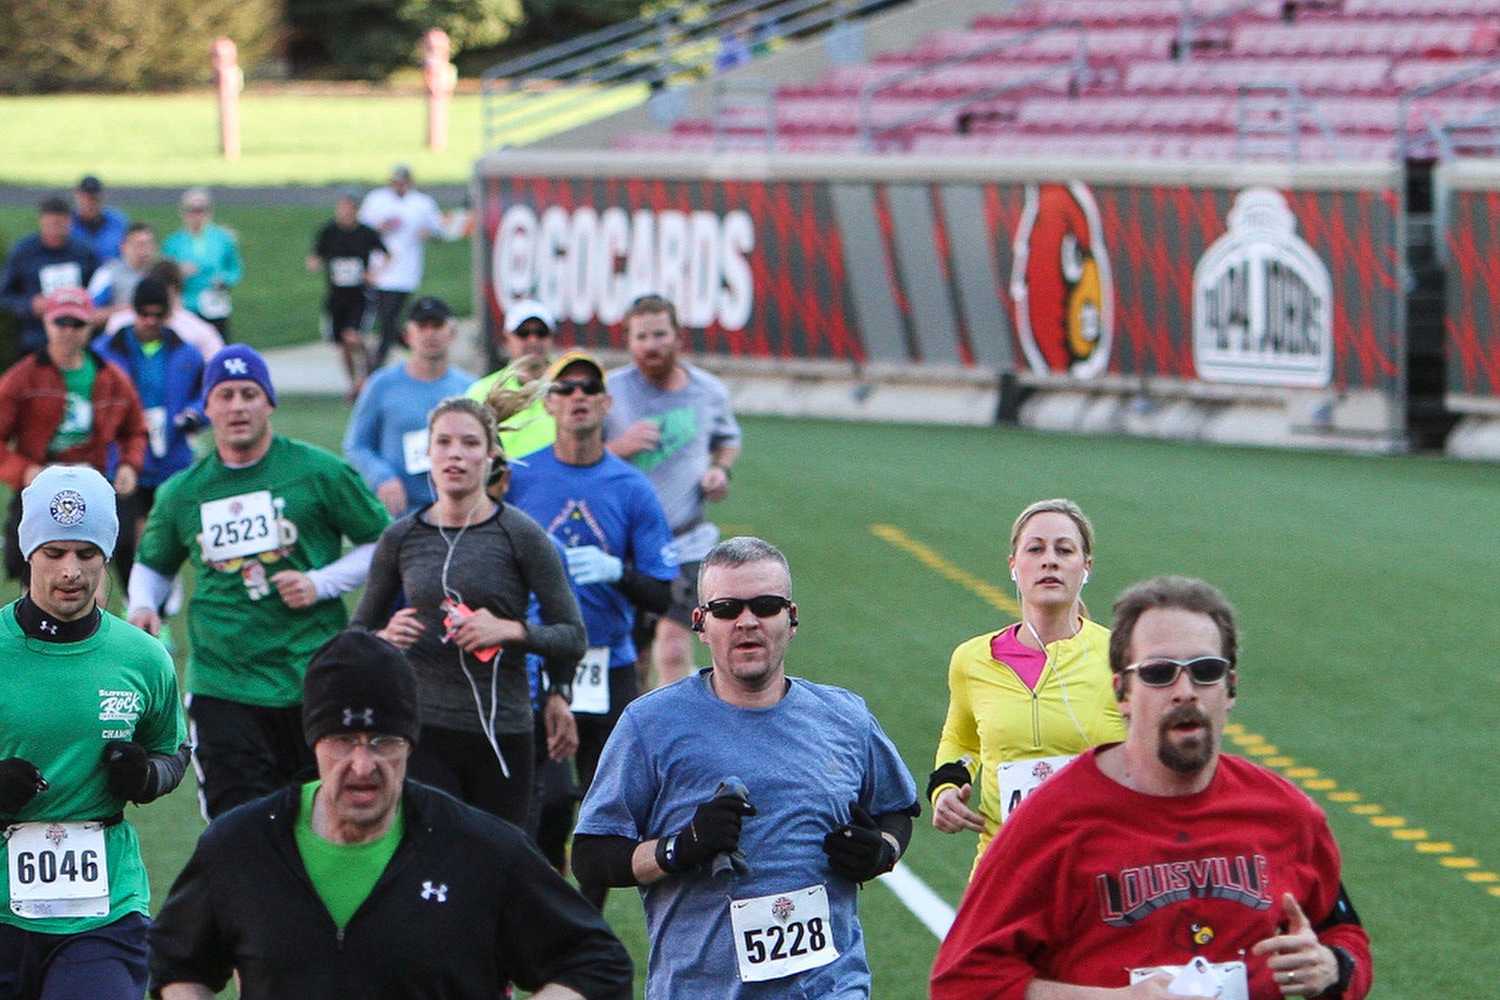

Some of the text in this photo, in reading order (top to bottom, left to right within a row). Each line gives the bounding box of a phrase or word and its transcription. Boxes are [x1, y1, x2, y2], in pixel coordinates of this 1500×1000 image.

[493, 204, 754, 331] @GOCARDS
[209, 514, 269, 548] 2523
[574, 663, 601, 686] 78
[17, 849, 99, 885] 6046
[1096, 854, 1275, 928] LOUISVILLE
[743, 916, 827, 965] 5228
